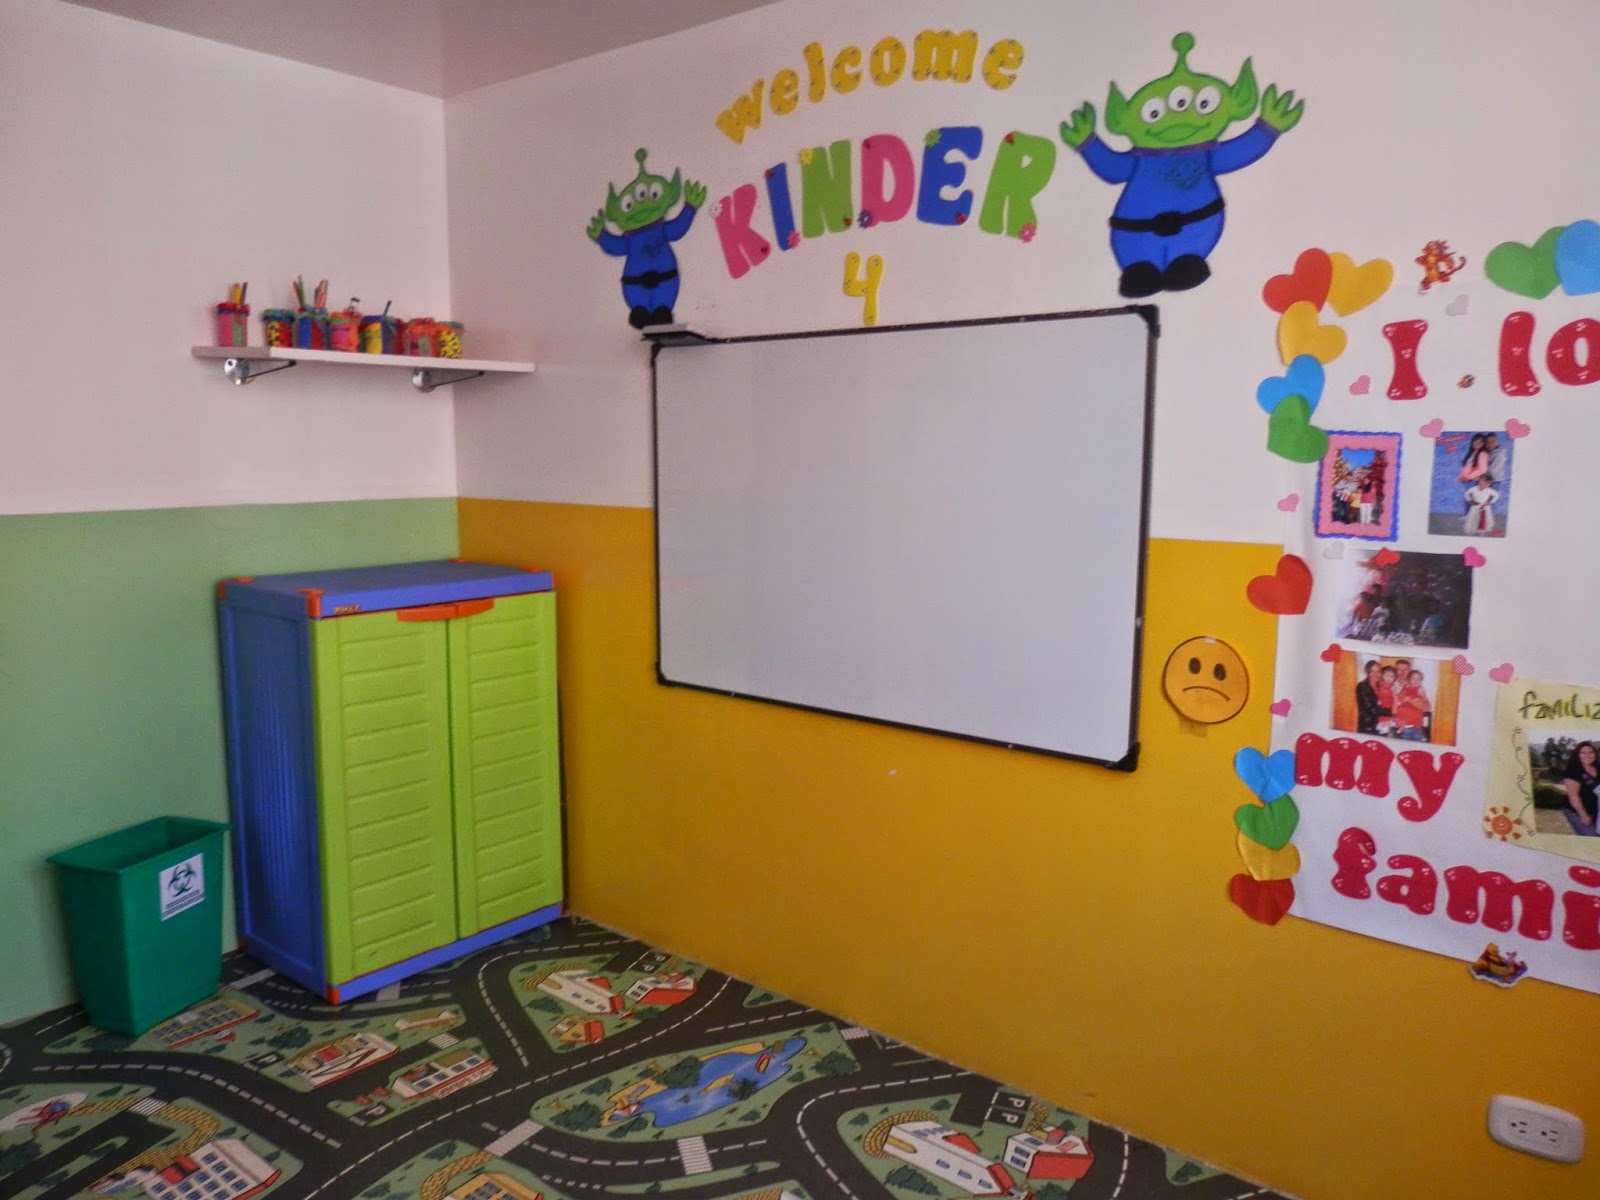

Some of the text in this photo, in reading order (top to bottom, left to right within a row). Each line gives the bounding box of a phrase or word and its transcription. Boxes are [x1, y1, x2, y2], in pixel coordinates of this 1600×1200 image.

[715, 28, 1025, 145] welcome
[711, 126, 1056, 279] KINDER
[843, 252, 883, 326] 4
[1382, 319, 1428, 400] I
[1294, 733, 1464, 822] my
[1001, 1113, 1019, 1123] P
[1008, 1097, 1025, 1108] P
